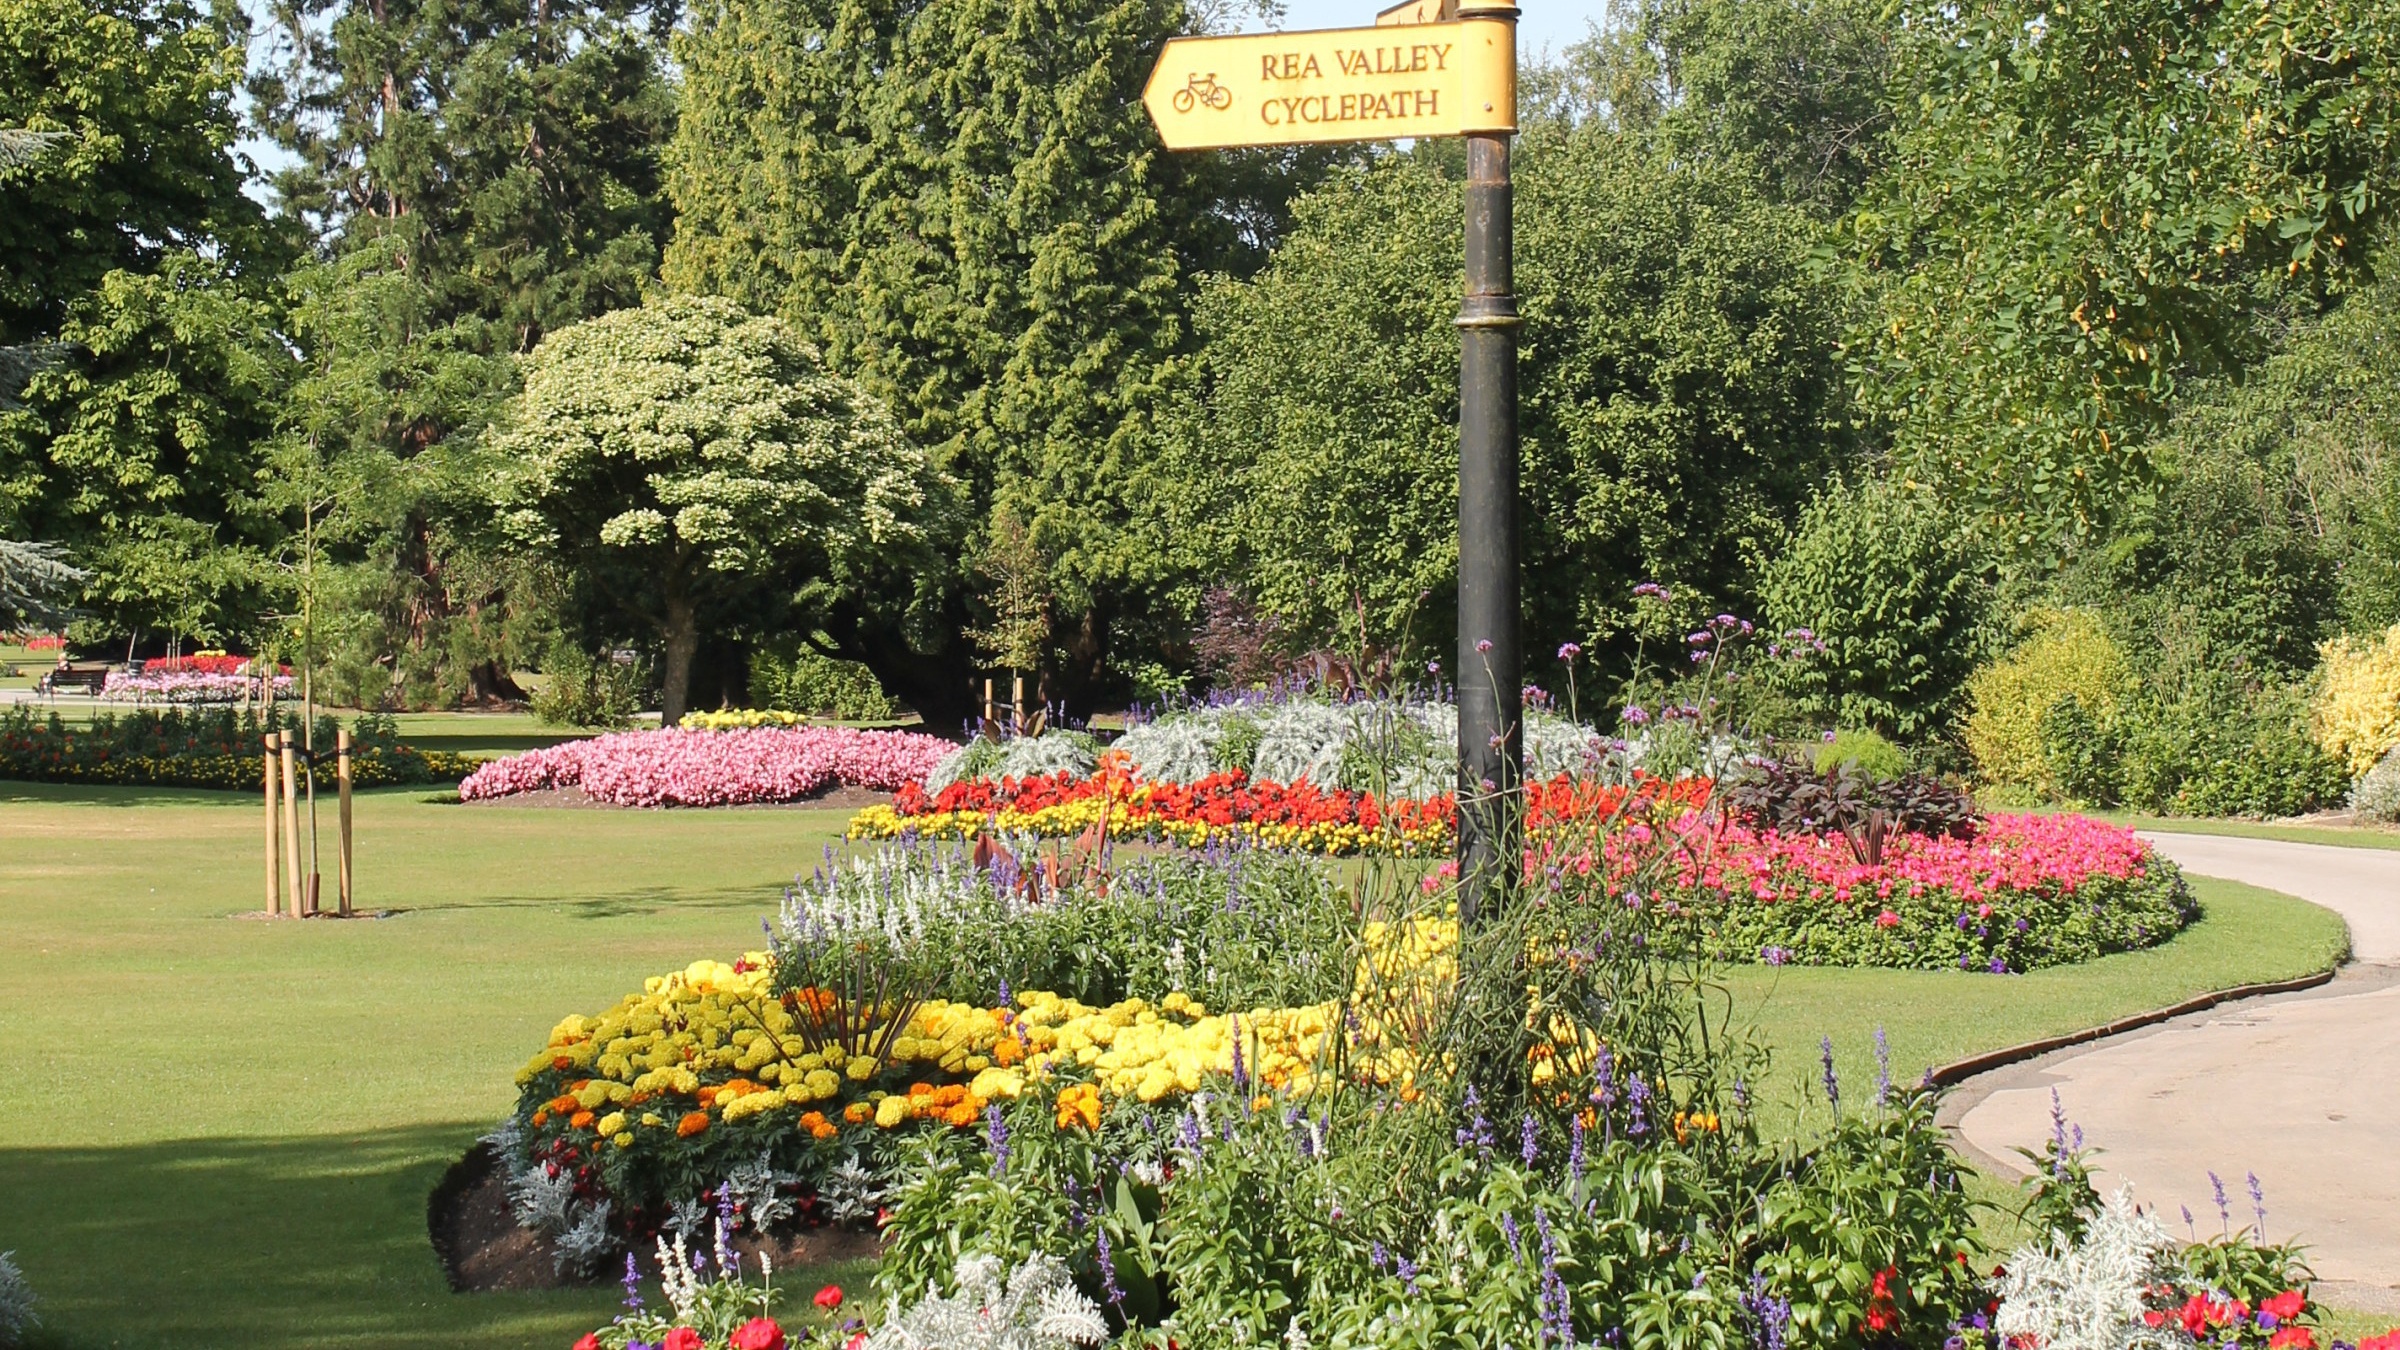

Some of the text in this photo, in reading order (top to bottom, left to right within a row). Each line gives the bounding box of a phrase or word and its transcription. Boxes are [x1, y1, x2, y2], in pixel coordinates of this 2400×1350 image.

[1261, 43, 1453, 81] REA VALLEY
[1261, 89, 1440, 126] CYCLEPATH
